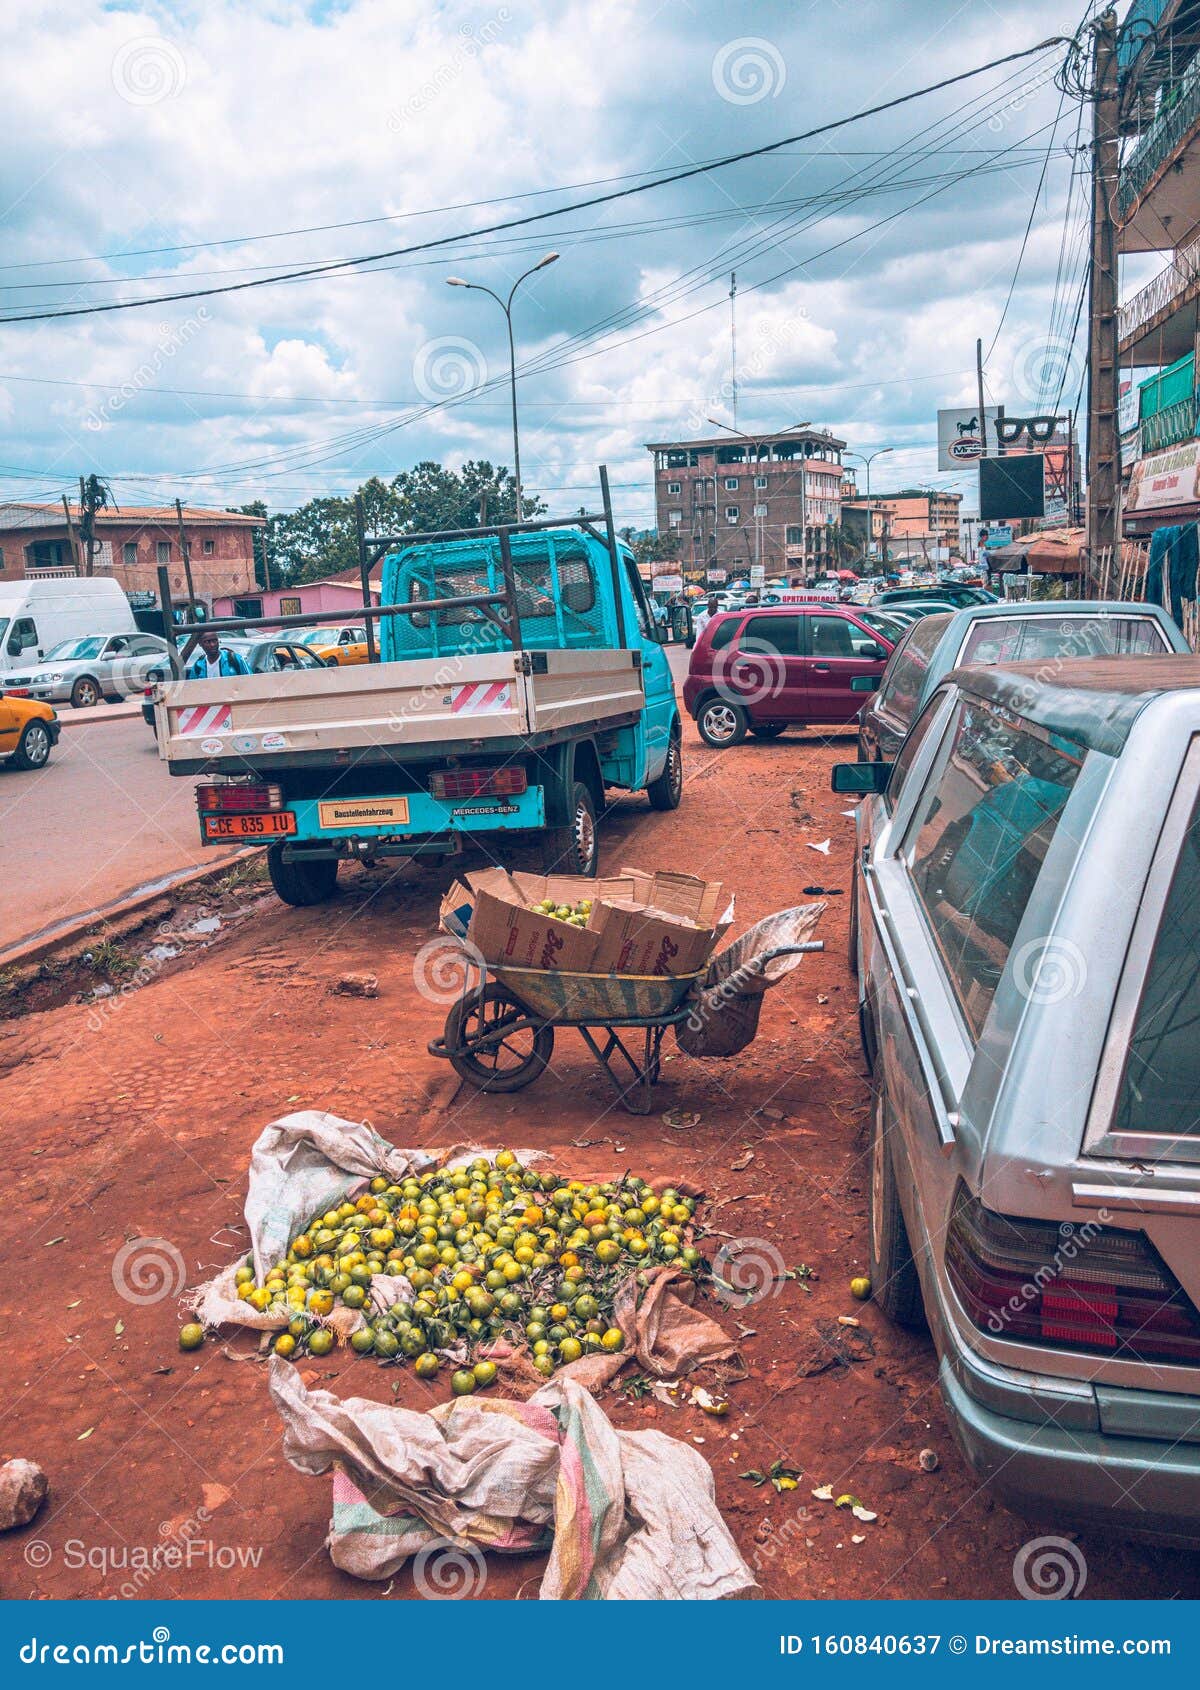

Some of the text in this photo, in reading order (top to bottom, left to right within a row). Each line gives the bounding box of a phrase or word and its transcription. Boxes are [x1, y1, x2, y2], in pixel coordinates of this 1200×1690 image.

[334, 808, 394, 819] Baustellenfahrzeug
[453, 806, 518, 816] MERCEDES-BENZ
[218, 818, 234, 834] CE
[241, 816, 264, 832] 835
